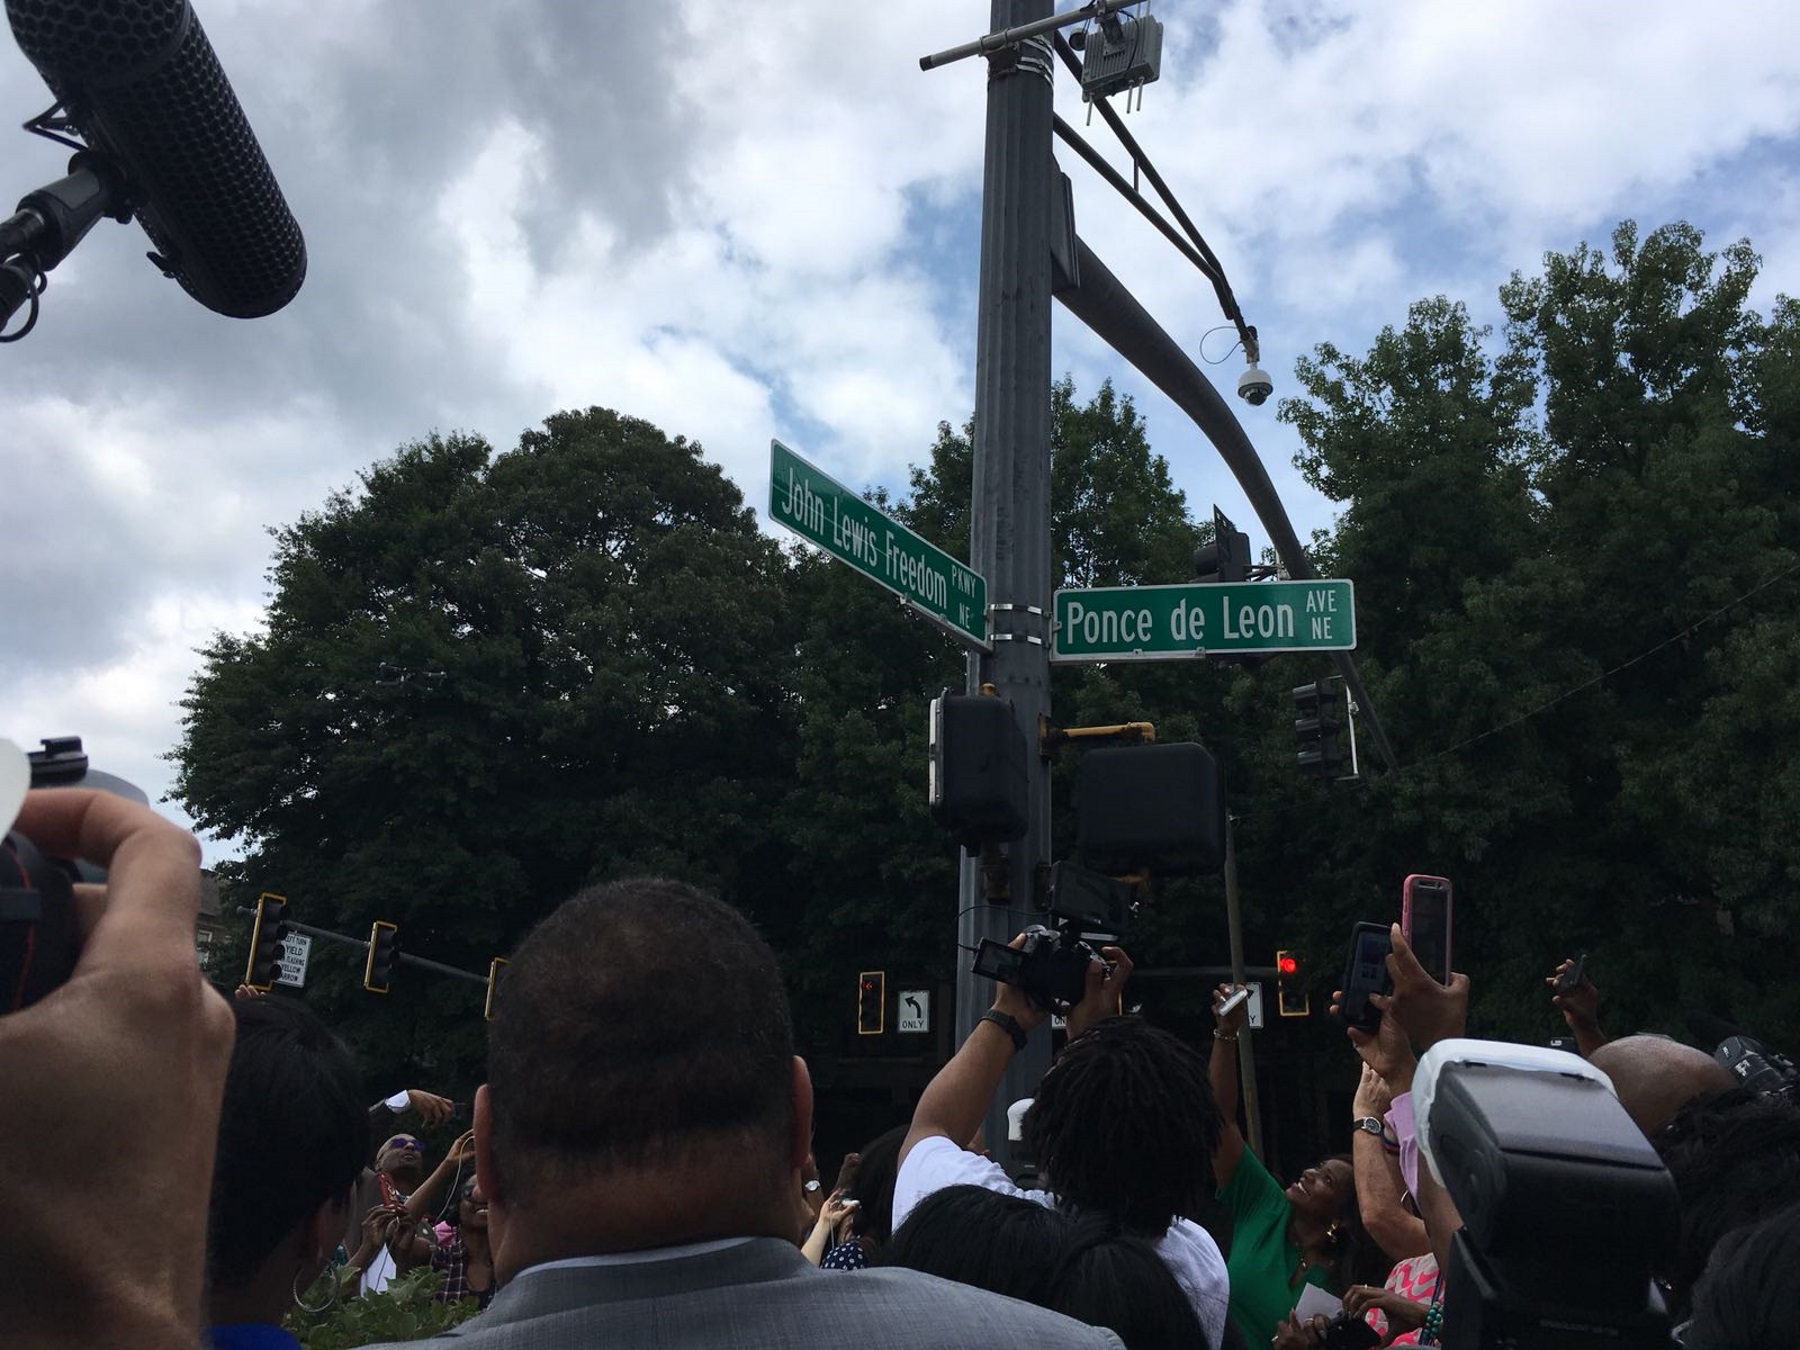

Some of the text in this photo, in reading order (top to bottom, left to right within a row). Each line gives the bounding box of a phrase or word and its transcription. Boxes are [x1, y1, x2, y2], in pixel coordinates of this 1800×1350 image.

[781, 467, 947, 610] John Lewis Freedom
[952, 565, 976, 598] PKWY
[1305, 590, 1338, 614] AVE
[959, 603, 971, 629] NE
[1067, 596, 1295, 645] Ponce de Leon
[1312, 617, 1333, 640] NE
[286, 945, 303, 956] YIELD
[281, 964, 301, 974] YELLOW
[902, 1020, 924, 1029] ONLY
